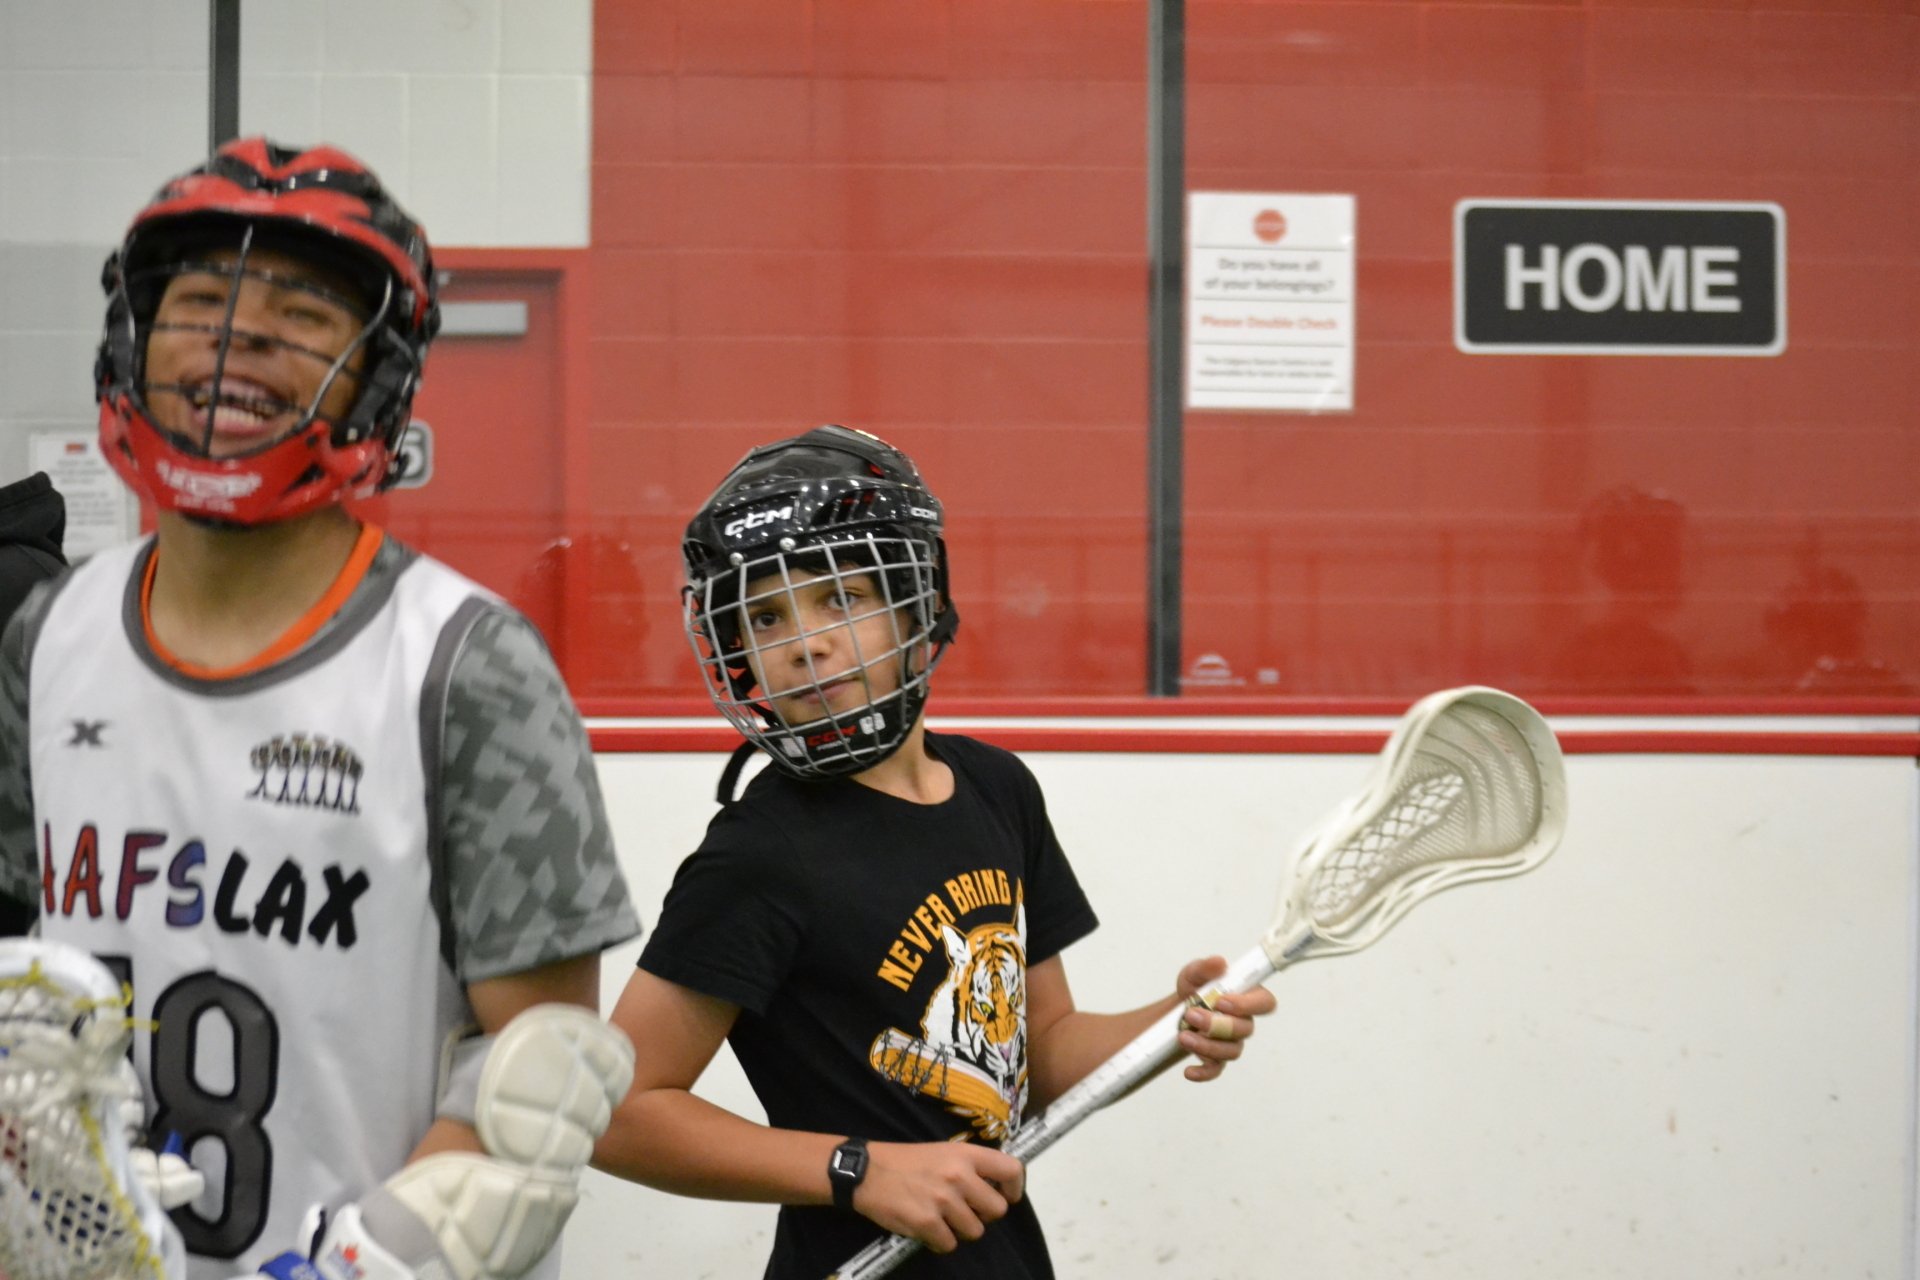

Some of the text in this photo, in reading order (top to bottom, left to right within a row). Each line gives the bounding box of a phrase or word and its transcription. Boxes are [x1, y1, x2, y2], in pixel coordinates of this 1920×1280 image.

[1218, 257, 1321, 273] Do you have all
[1204, 276, 1336, 294] of your belongings?
[1505, 243, 1742, 313] HOME
[1201, 315, 1337, 331] Please Double Check
[724, 506, 794, 537] CCM
[877, 892, 957, 993] NEVER
[944, 868, 1012, 916] BRING
